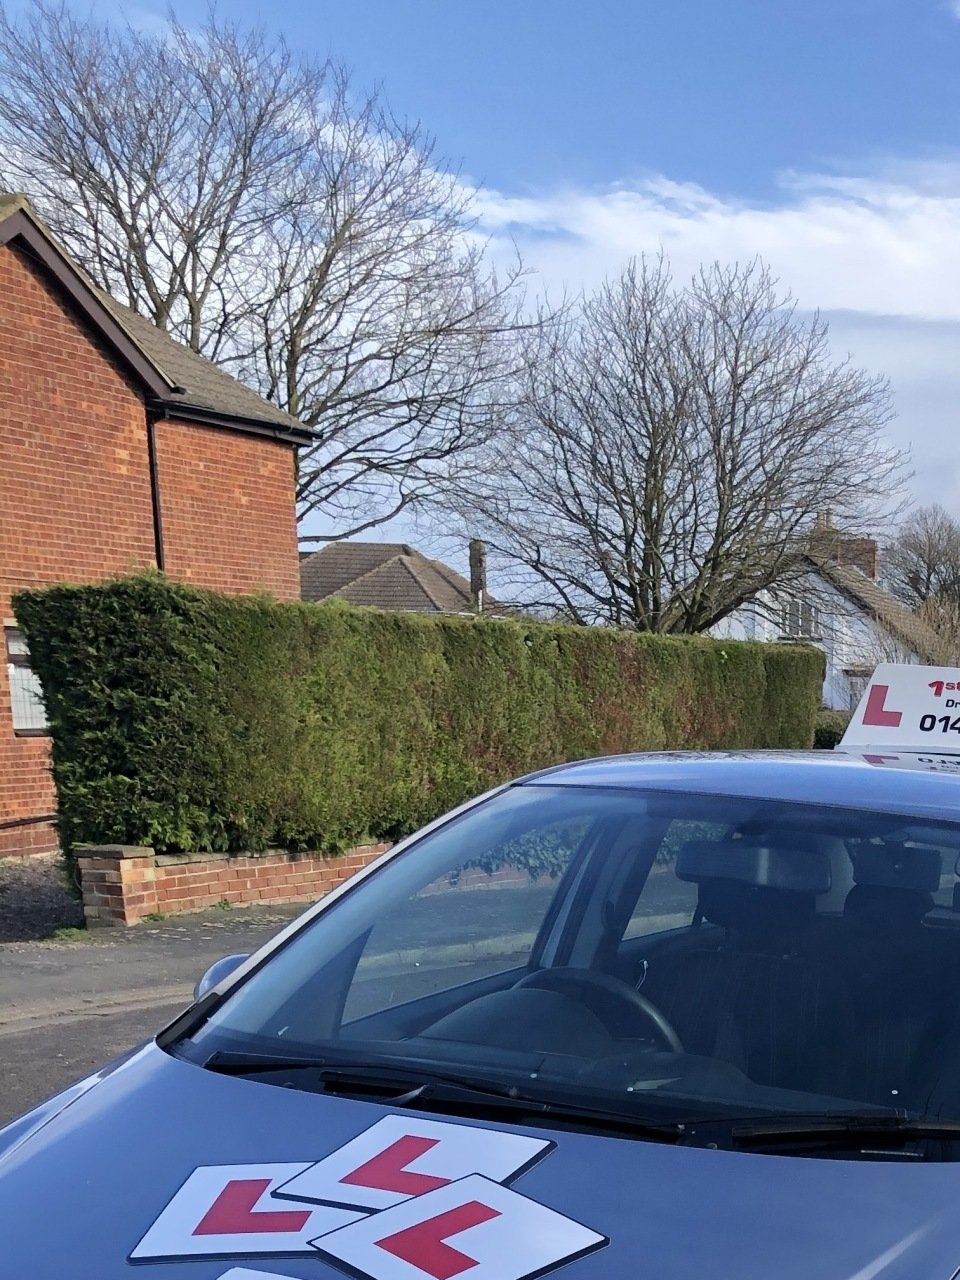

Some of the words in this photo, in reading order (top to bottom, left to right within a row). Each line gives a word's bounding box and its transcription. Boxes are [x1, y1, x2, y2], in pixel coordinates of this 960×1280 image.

[862, 684, 903, 727] L
[338, 1134, 452, 1196] L
[191, 1178, 313, 1236] L
[372, 1200, 503, 1280] L
